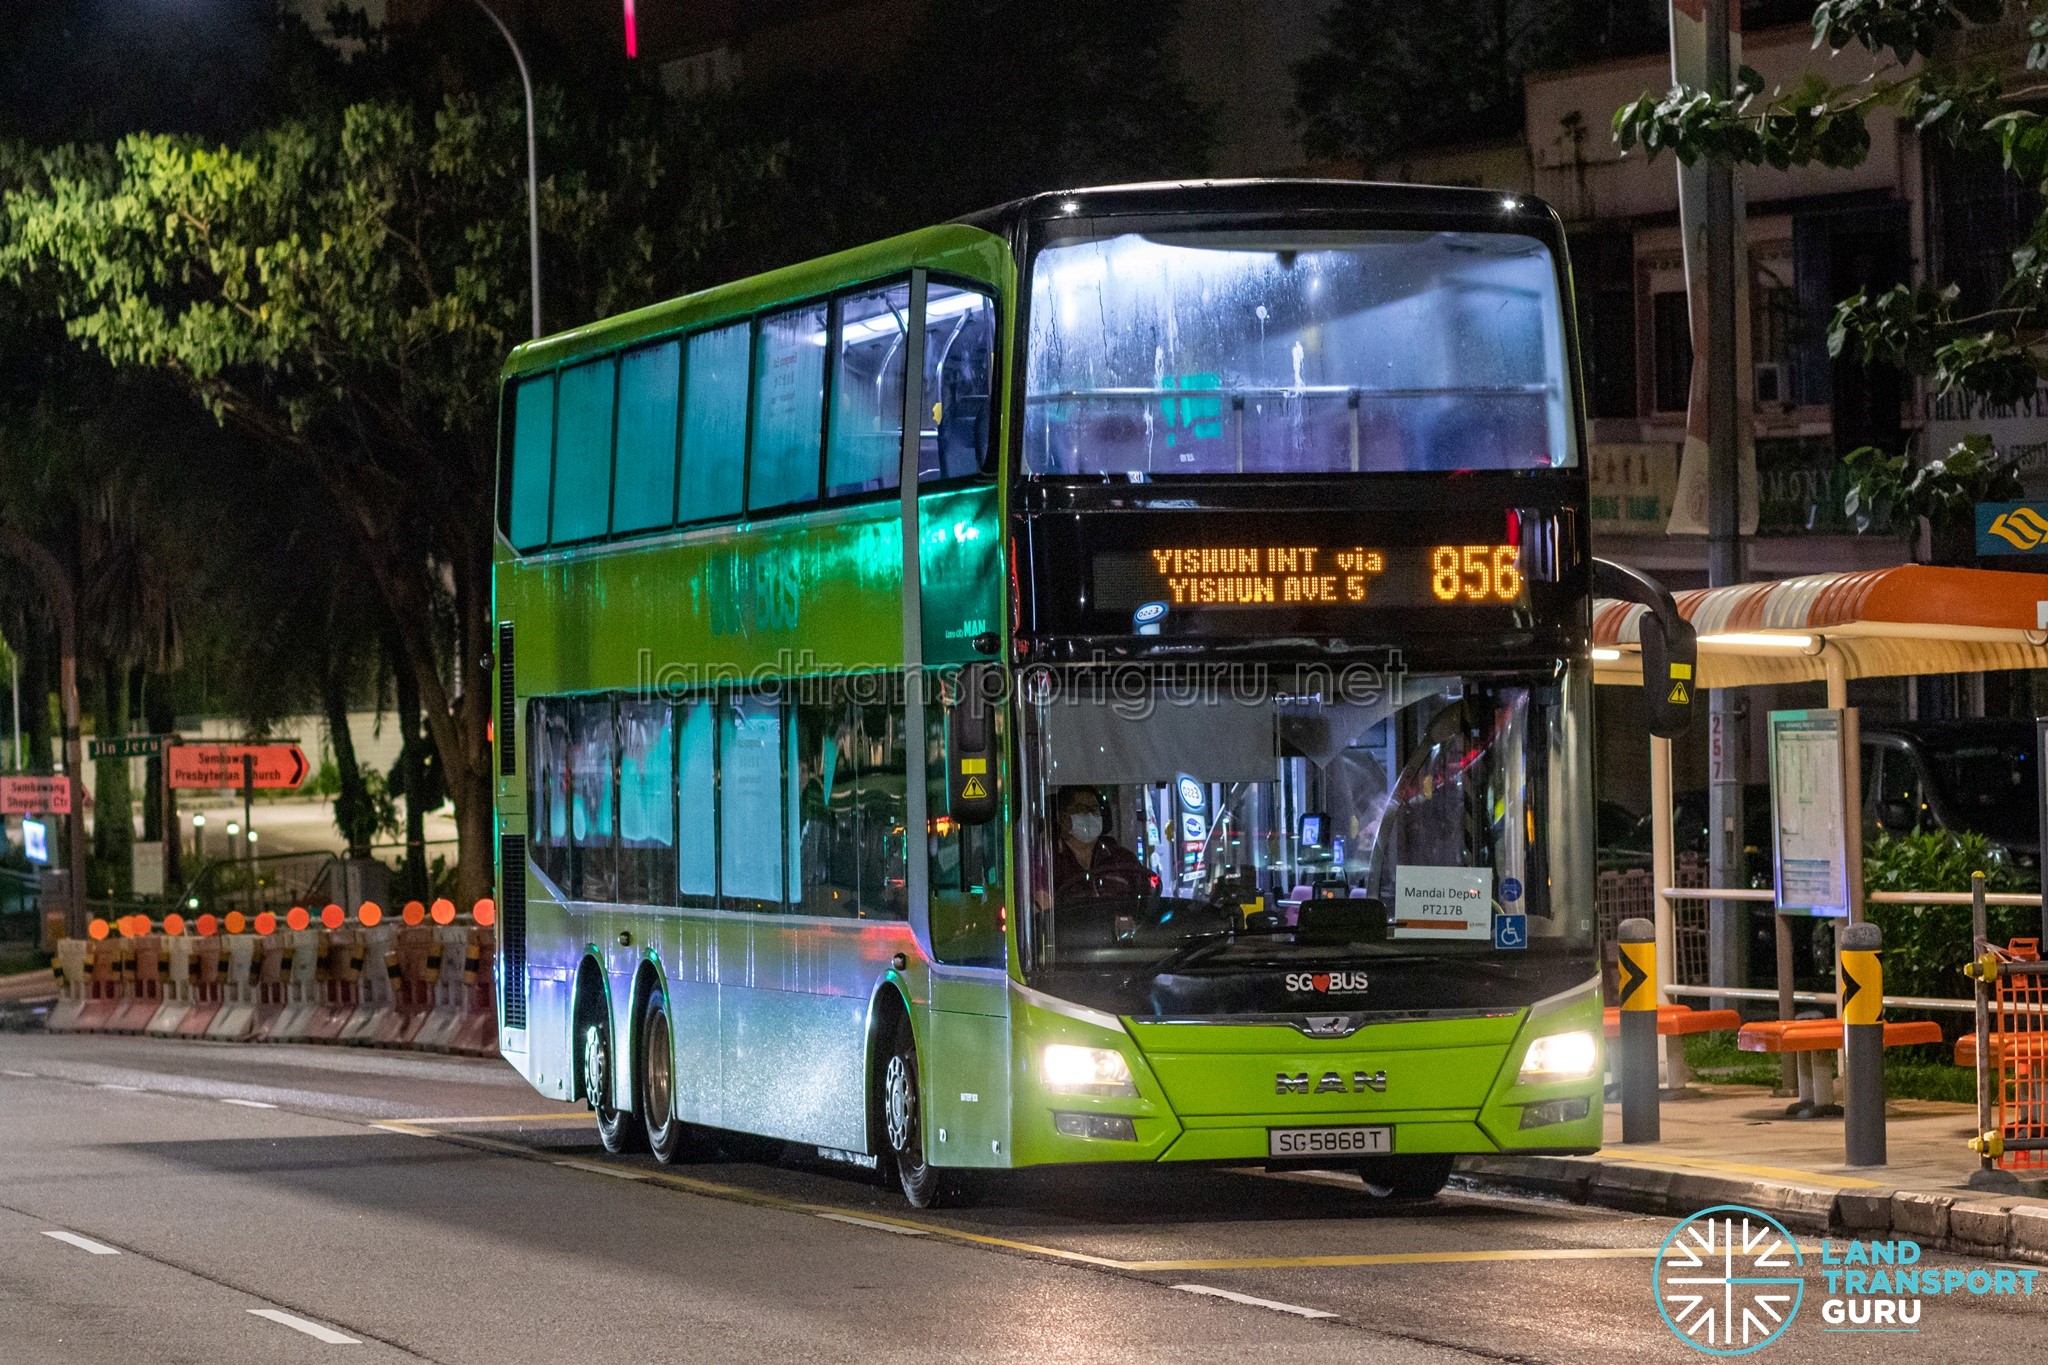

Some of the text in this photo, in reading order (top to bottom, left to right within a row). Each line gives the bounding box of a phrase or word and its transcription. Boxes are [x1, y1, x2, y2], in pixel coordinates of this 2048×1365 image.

[1153, 545, 1521, 599] YISHUN INT via 856
[1168, 576, 1365, 602] YISHUN AVE 5
[963, 619, 986, 637] MAN
[199, 752, 259, 766] Sembawag
[175, 770, 281, 783] Presbyterian hurch
[12, 782, 65, 794] Sembawang
[1404, 887, 1481, 901] Mandai Depot
[1422, 904, 1463, 916] PT217B
[1285, 972, 1368, 992] SG BUS
[1276, 1070, 1386, 1095] MAN
[1280, 1131, 1381, 1152] SG5868T
